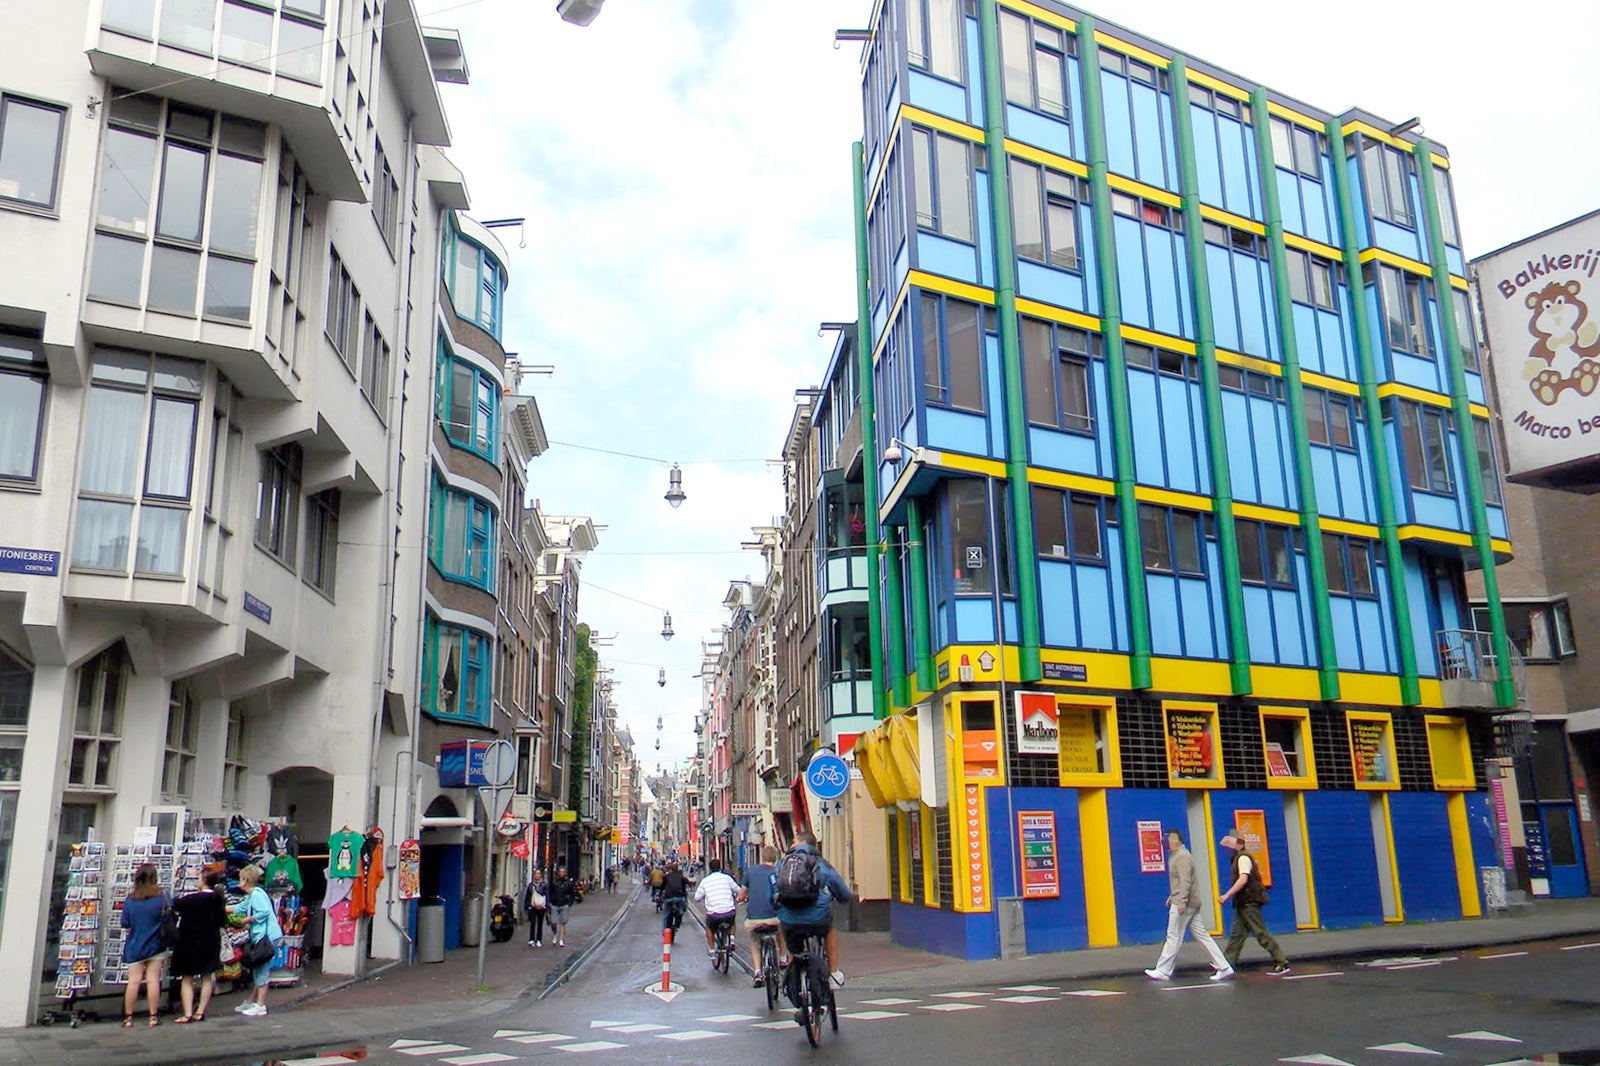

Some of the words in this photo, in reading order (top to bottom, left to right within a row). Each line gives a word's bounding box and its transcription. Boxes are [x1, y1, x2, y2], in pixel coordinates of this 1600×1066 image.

[1498, 249, 1600, 299] Bakkerij
[1514, 410, 1571, 439] Marco
[1023, 721, 1058, 738] Marlboro
[470, 767, 483, 775] SNE
